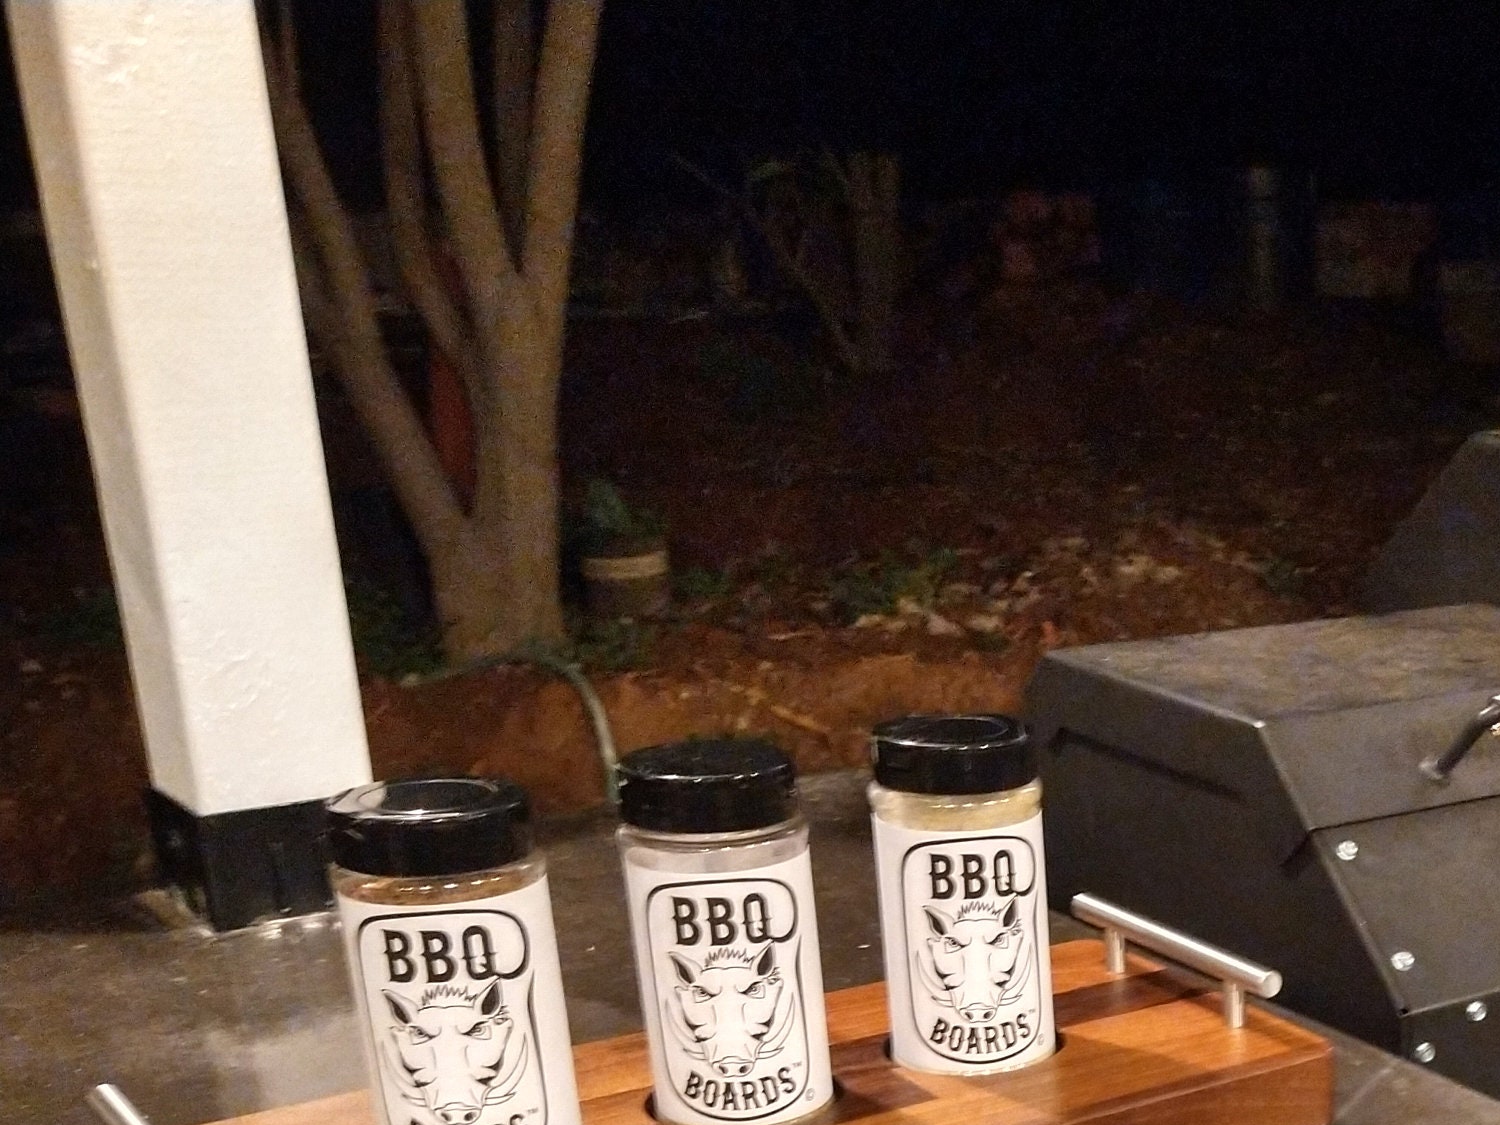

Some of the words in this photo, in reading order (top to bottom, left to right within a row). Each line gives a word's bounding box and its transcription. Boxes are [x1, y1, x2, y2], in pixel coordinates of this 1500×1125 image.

[928, 848, 1019, 901] BBQ
[669, 892, 777, 948] BBQ
[381, 924, 504, 985] BBQ
[929, 1013, 1031, 1055] BOARDS
[683, 1066, 798, 1112] BOARDS
